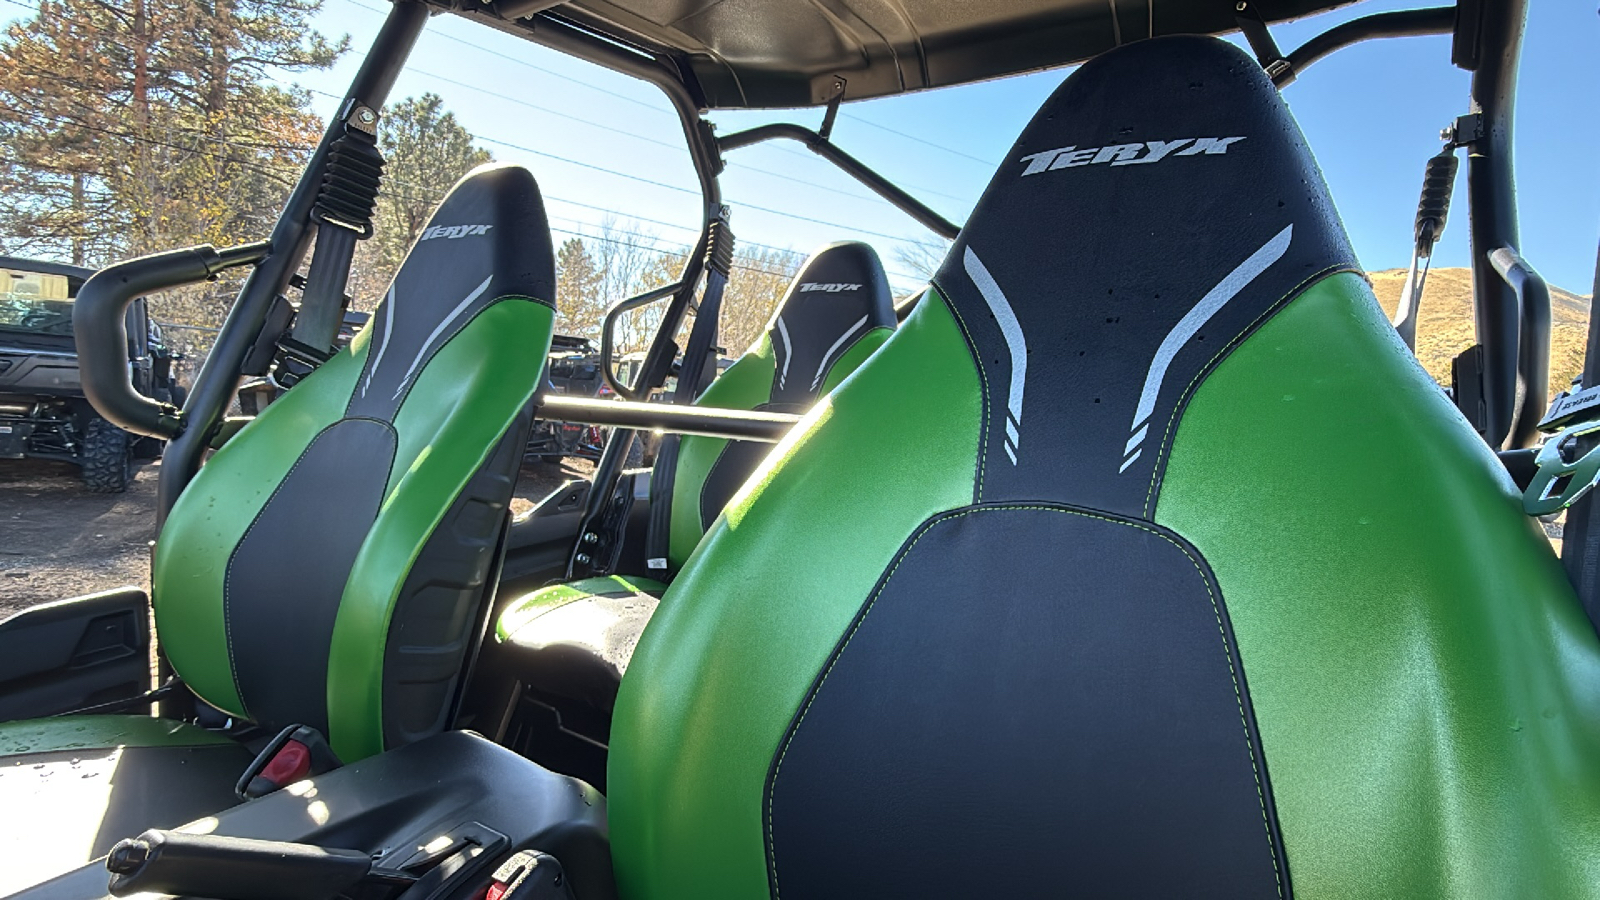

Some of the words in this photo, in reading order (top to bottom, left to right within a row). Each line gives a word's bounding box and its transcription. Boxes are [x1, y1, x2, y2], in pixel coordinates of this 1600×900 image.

[1019, 136, 1248, 177] TERYX
[420, 224, 494, 241] TERYX
[799, 282, 863, 293] TERYX
